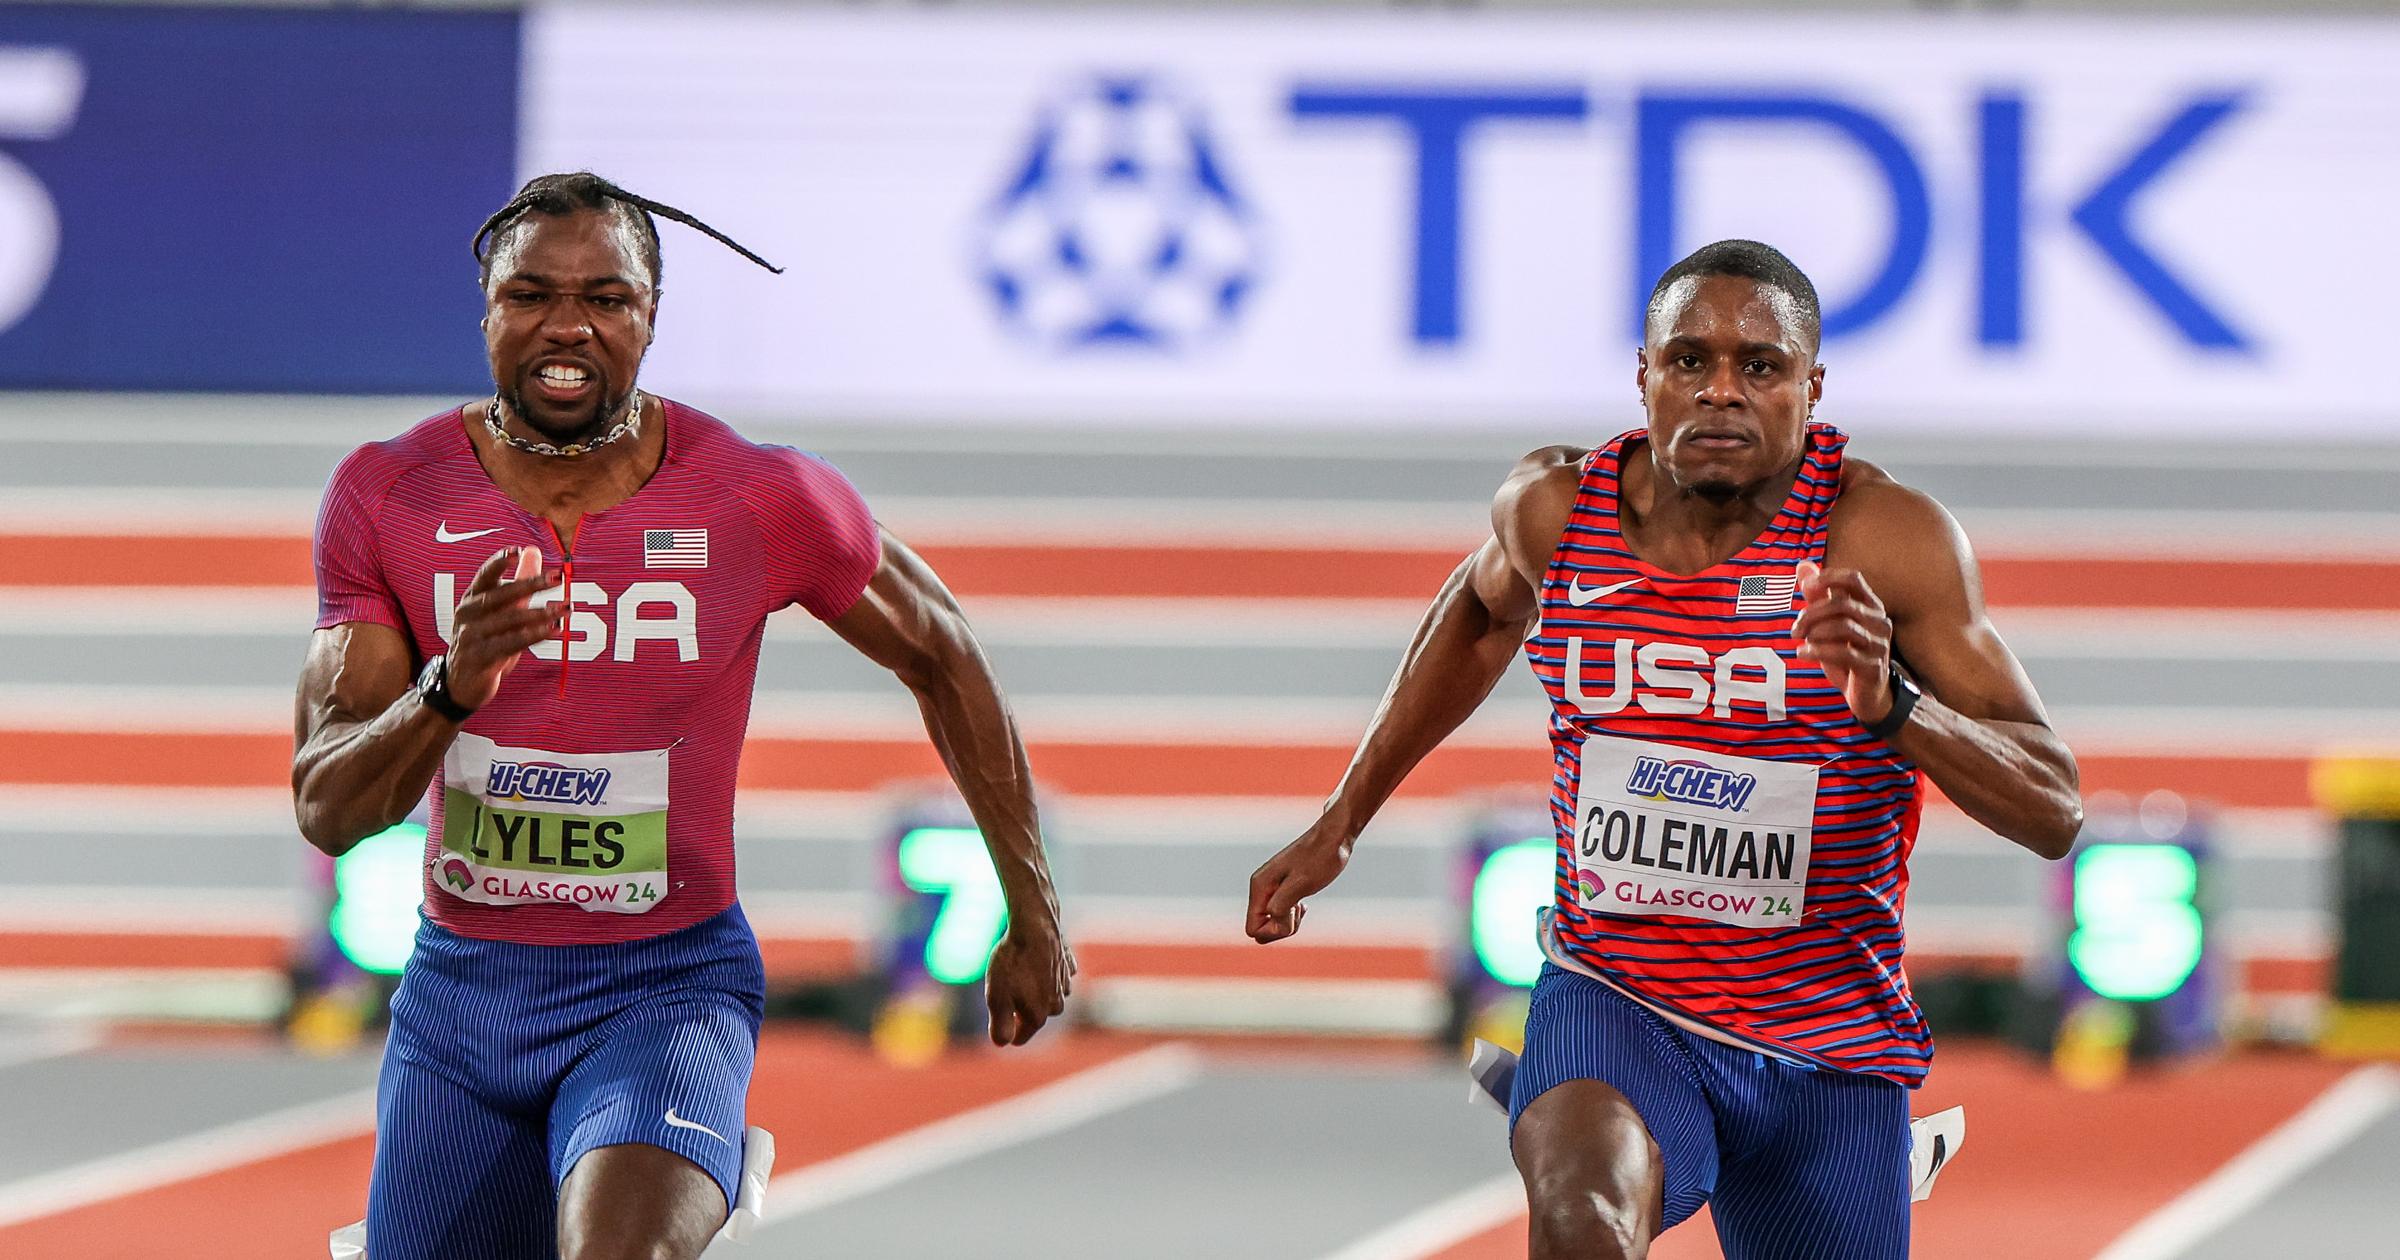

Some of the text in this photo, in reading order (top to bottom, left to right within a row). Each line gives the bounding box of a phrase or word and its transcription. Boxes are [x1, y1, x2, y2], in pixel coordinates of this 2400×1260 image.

[1284, 84, 2262, 354] TDK
[1564, 636, 1787, 722] USA
[486, 759, 612, 805] HI-CHEW
[1626, 756, 1757, 812] HI-CHEW
[470, 806, 625, 869] LYLES
[1582, 806, 1796, 880] COLEMAN
[483, 876, 657, 904] GLASGOW 24
[898, 827, 1009, 986] 7
[1614, 881, 1793, 916] GLASGOW 24
[2067, 843, 2203, 1002] 5
